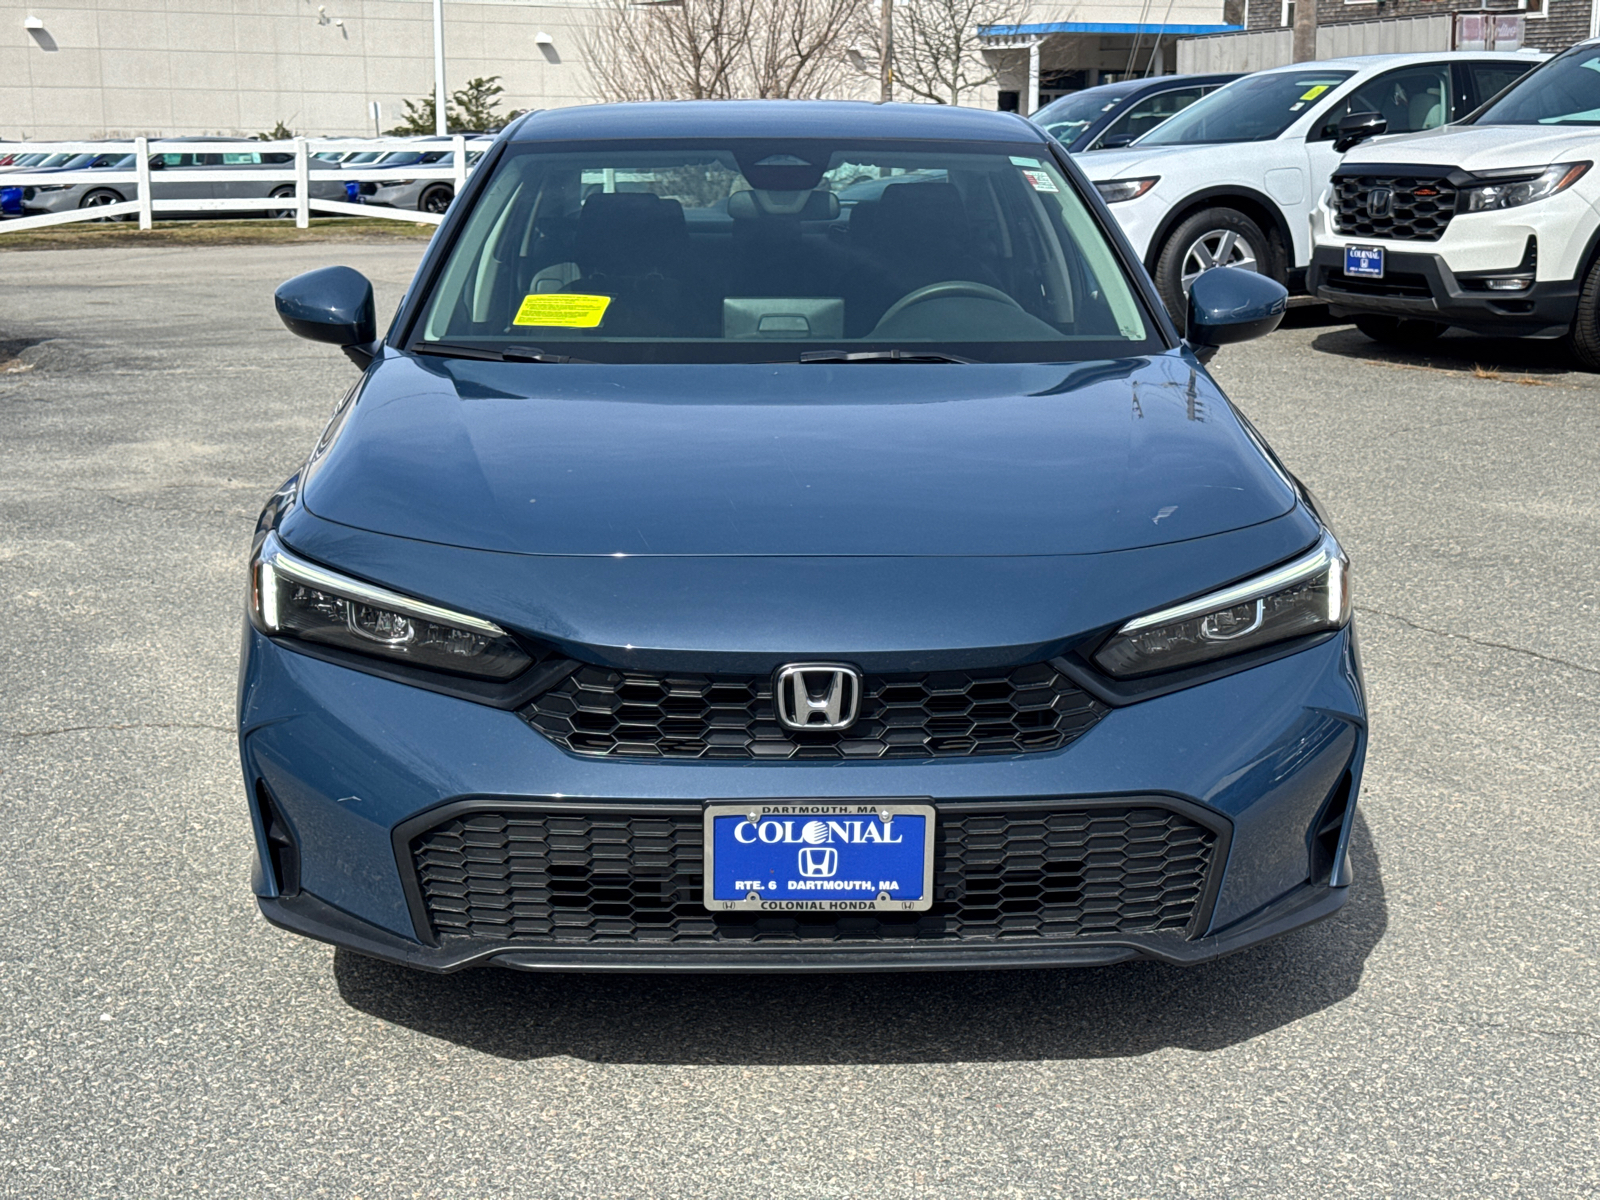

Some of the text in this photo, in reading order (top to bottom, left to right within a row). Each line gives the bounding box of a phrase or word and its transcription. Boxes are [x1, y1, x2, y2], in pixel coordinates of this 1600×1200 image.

[762, 806, 878, 814] DARTMOUTH, MA
[734, 820, 903, 845] COLONIAL
[735, 881, 899, 892] RTE. 6 DARTMOUTH, MA
[760, 901, 826, 910] COLONIAL
[830, 901, 876, 910] HONDA
